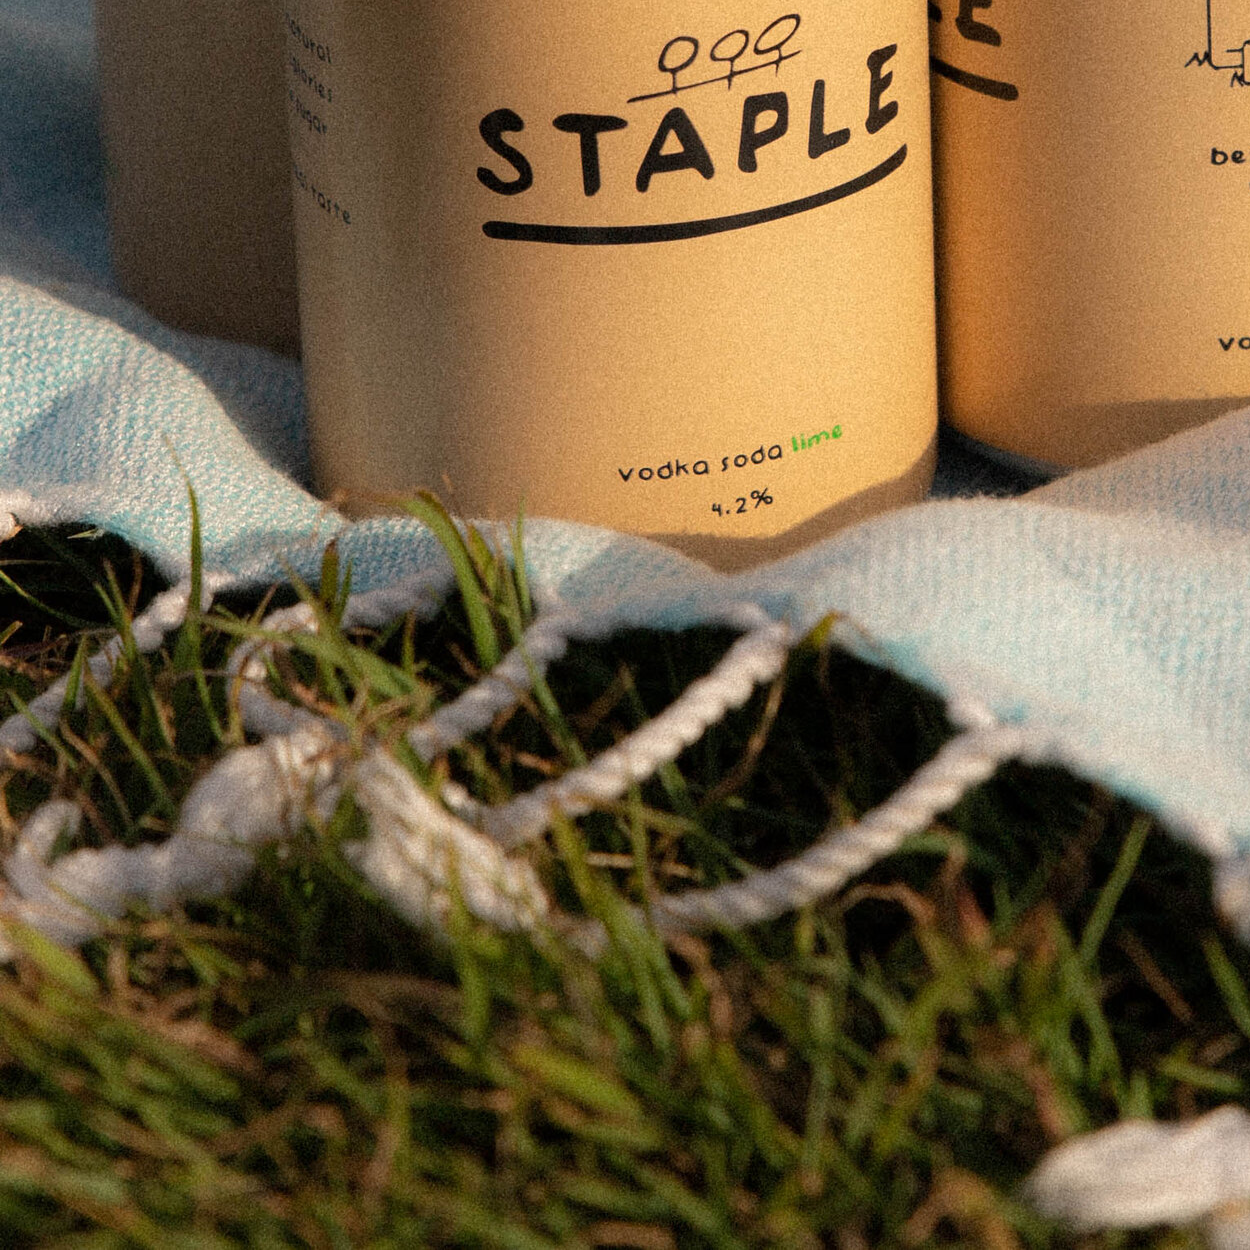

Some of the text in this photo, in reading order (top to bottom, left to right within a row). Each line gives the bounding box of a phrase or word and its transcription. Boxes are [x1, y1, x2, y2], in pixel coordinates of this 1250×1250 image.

[285, 12, 332, 65] atural
[476, 43, 899, 197] STAPLE
[617, 424, 844, 483] vodka soda lime
[711, 487, 774, 517] 4.2%
